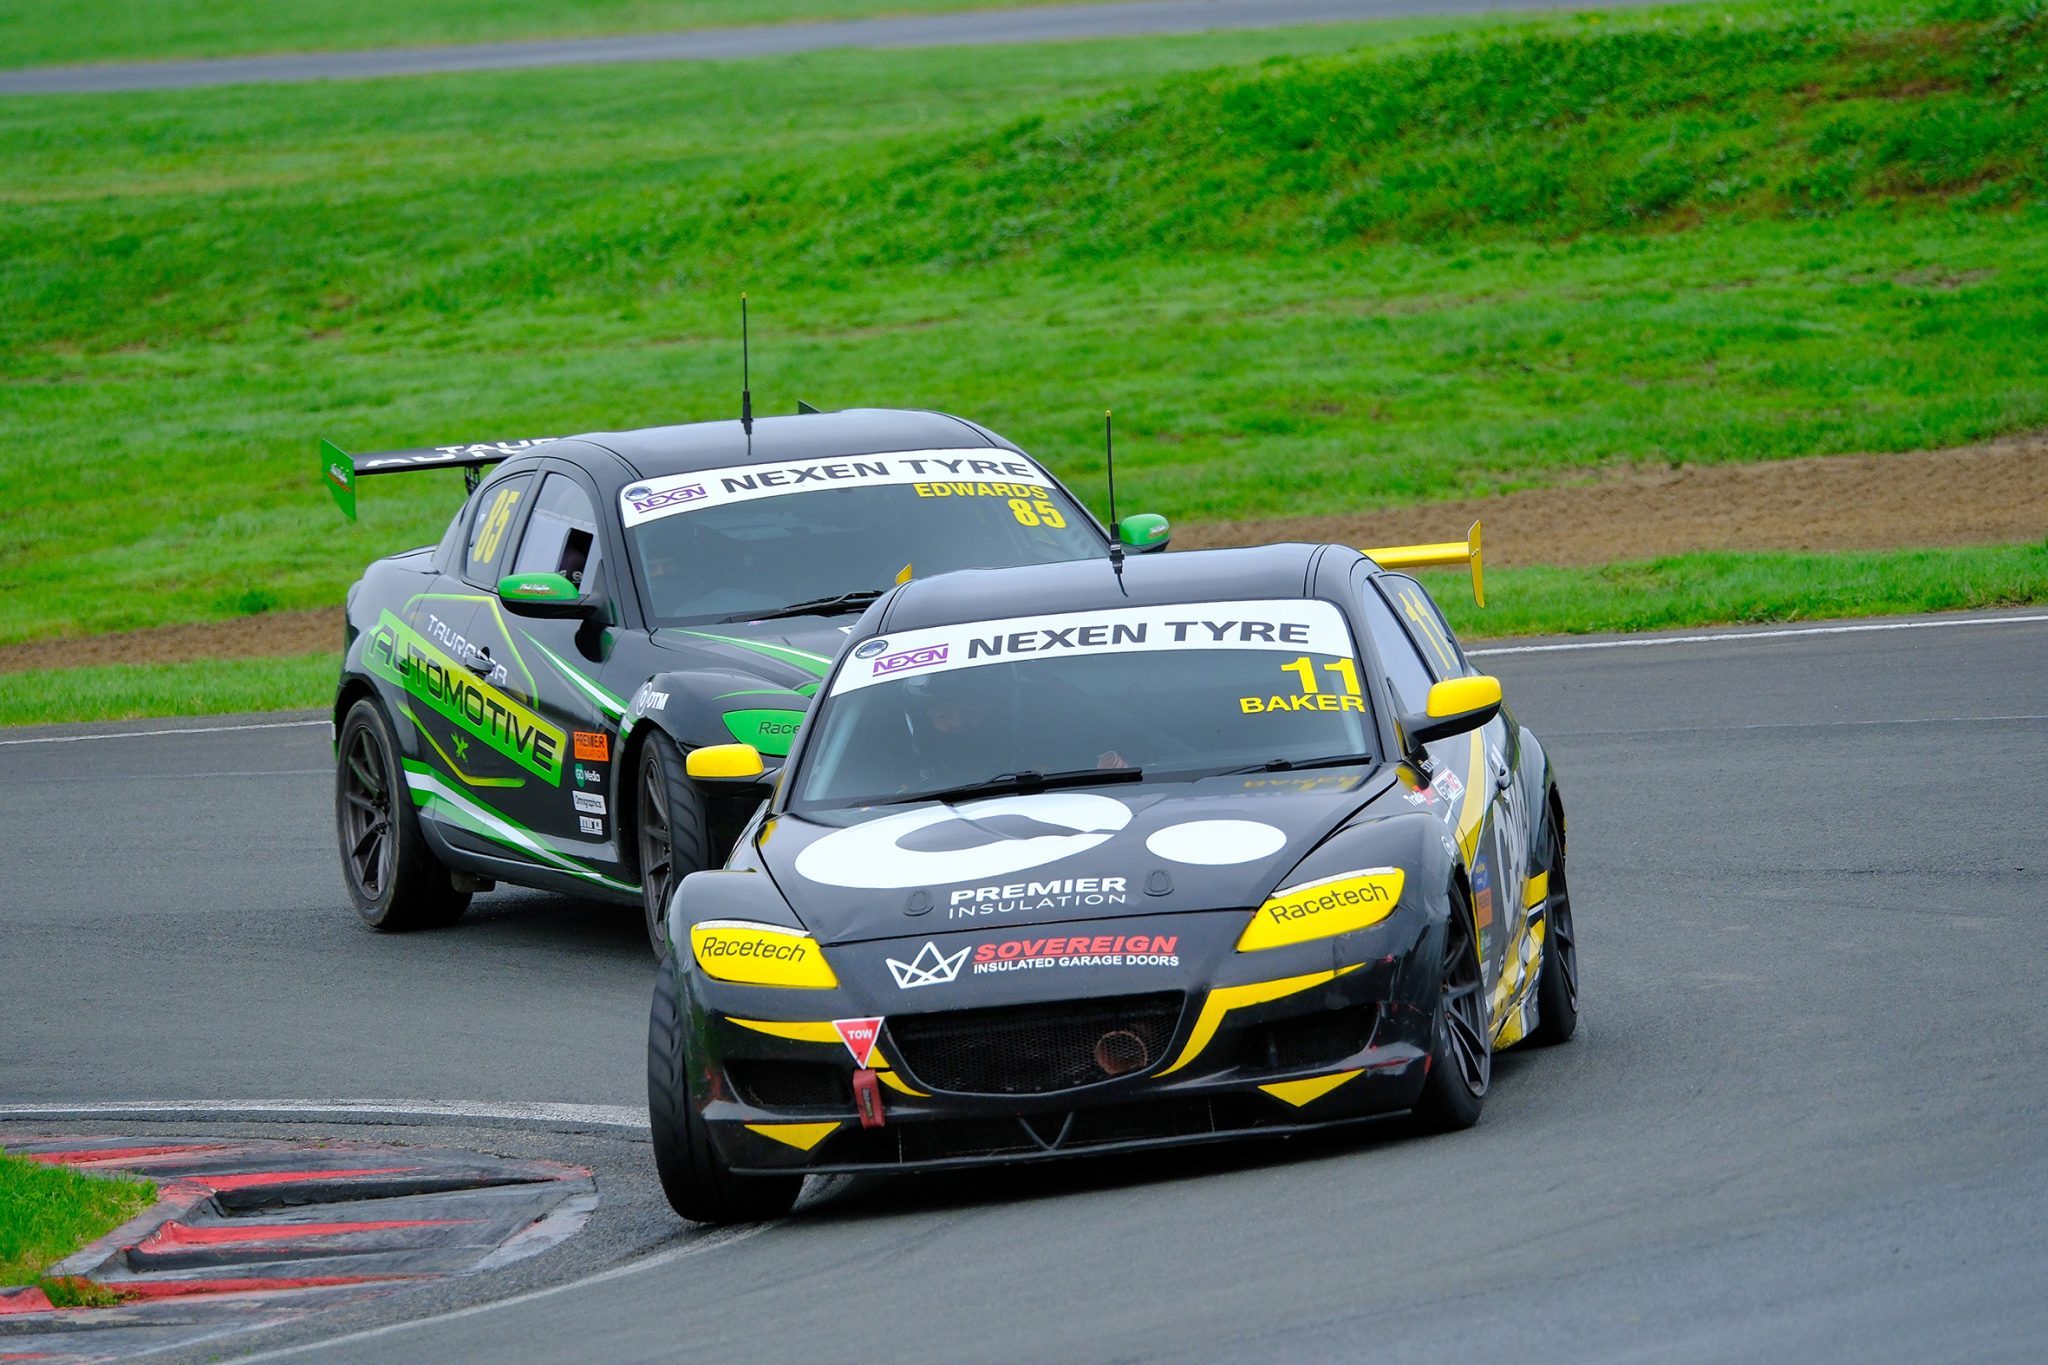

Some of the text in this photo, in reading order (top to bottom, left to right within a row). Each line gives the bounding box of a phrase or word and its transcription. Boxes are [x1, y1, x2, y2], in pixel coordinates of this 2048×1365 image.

[721, 459, 1034, 493] NEXEN TYRE
[633, 486, 706, 511] NEXEN
[913, 482, 1049, 499] EDWARDS
[473, 488, 520, 564] 85
[1008, 498, 1067, 529] 85
[427, 614, 508, 685] TAURAA
[967, 620, 1310, 659] NEXEN TYRE
[873, 647, 948, 673] NEXEN
[1281, 656, 1361, 695] 11
[371, 624, 557, 773] AUTOMOTIVE
[1239, 694, 1365, 713] BAKER
[758, 721, 801, 735] Race
[951, 876, 1127, 905] PREMIER
[1268, 883, 1389, 924] Racetech
[949, 894, 1127, 919] INSULATION
[701, 936, 806, 962] Racetech
[974, 935, 1179, 961] SOVEREIGN
[973, 955, 1180, 974] INSULATED GARAGE DOORS
[847, 1028, 873, 1040] TOW
